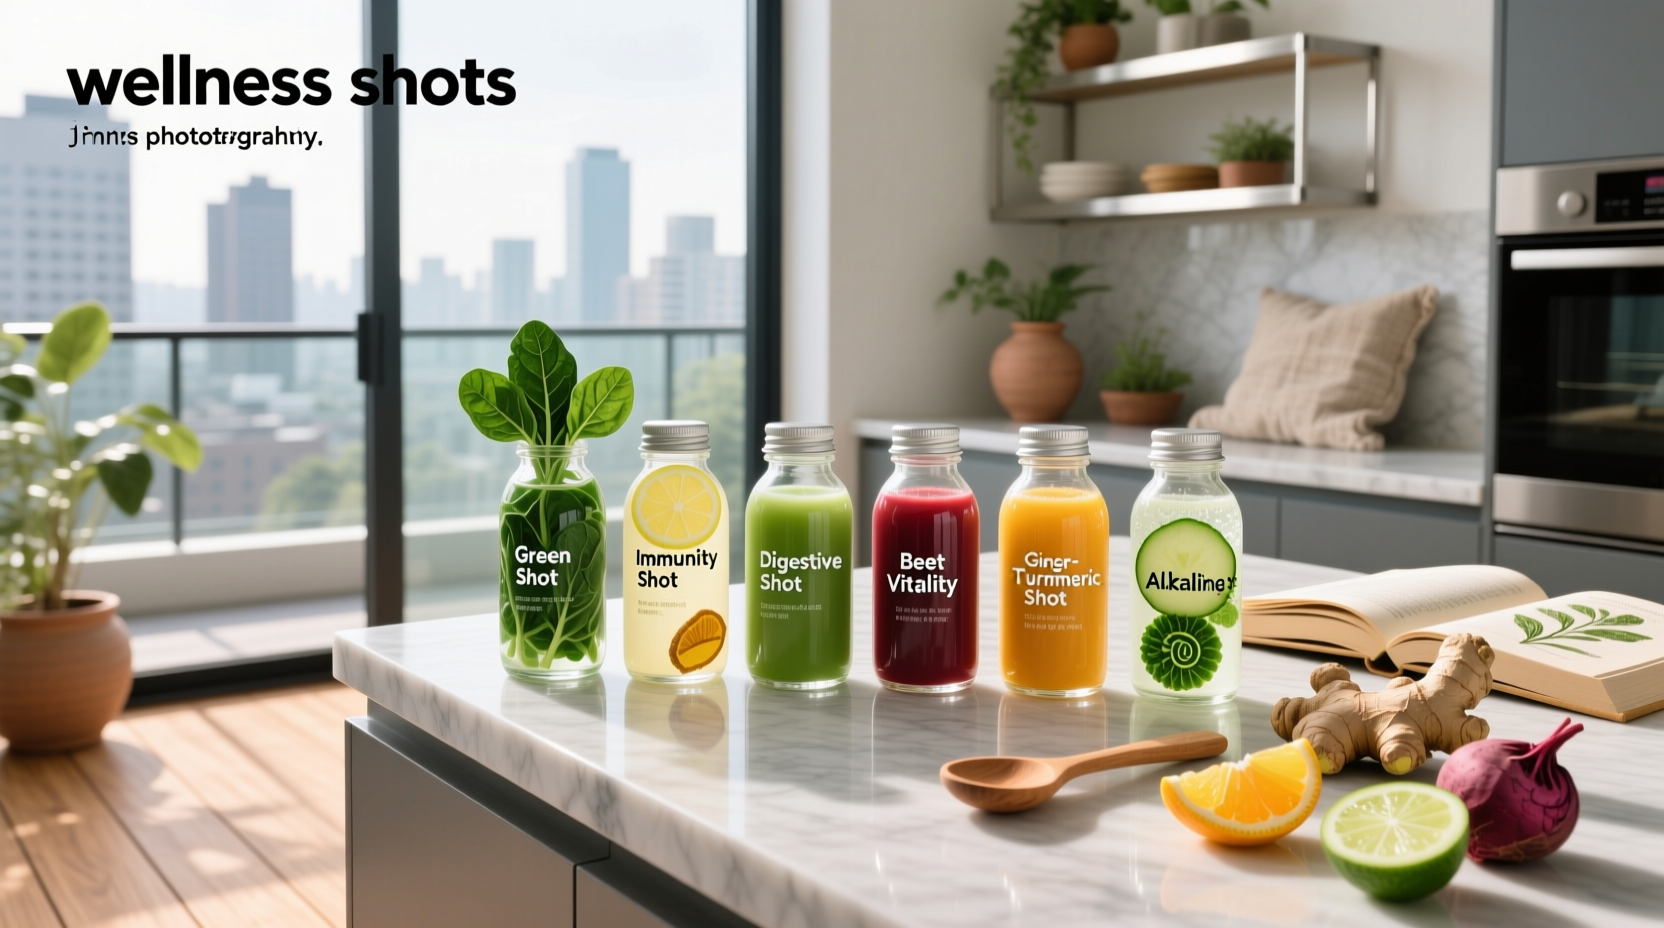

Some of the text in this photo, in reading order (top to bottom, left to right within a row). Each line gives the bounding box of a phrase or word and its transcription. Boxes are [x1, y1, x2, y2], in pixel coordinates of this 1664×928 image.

[515, 545, 571, 564] Green
[636, 548, 718, 570] Immunity
[760, 550, 842, 575] Digestive
[900, 552, 946, 571] Beet
[515, 567, 559, 586] Shot
[637, 570, 678, 588] Shot
[760, 573, 802, 592] Shot
[886, 573, 959, 598] Vitality
[1024, 589, 1067, 606] Shot
